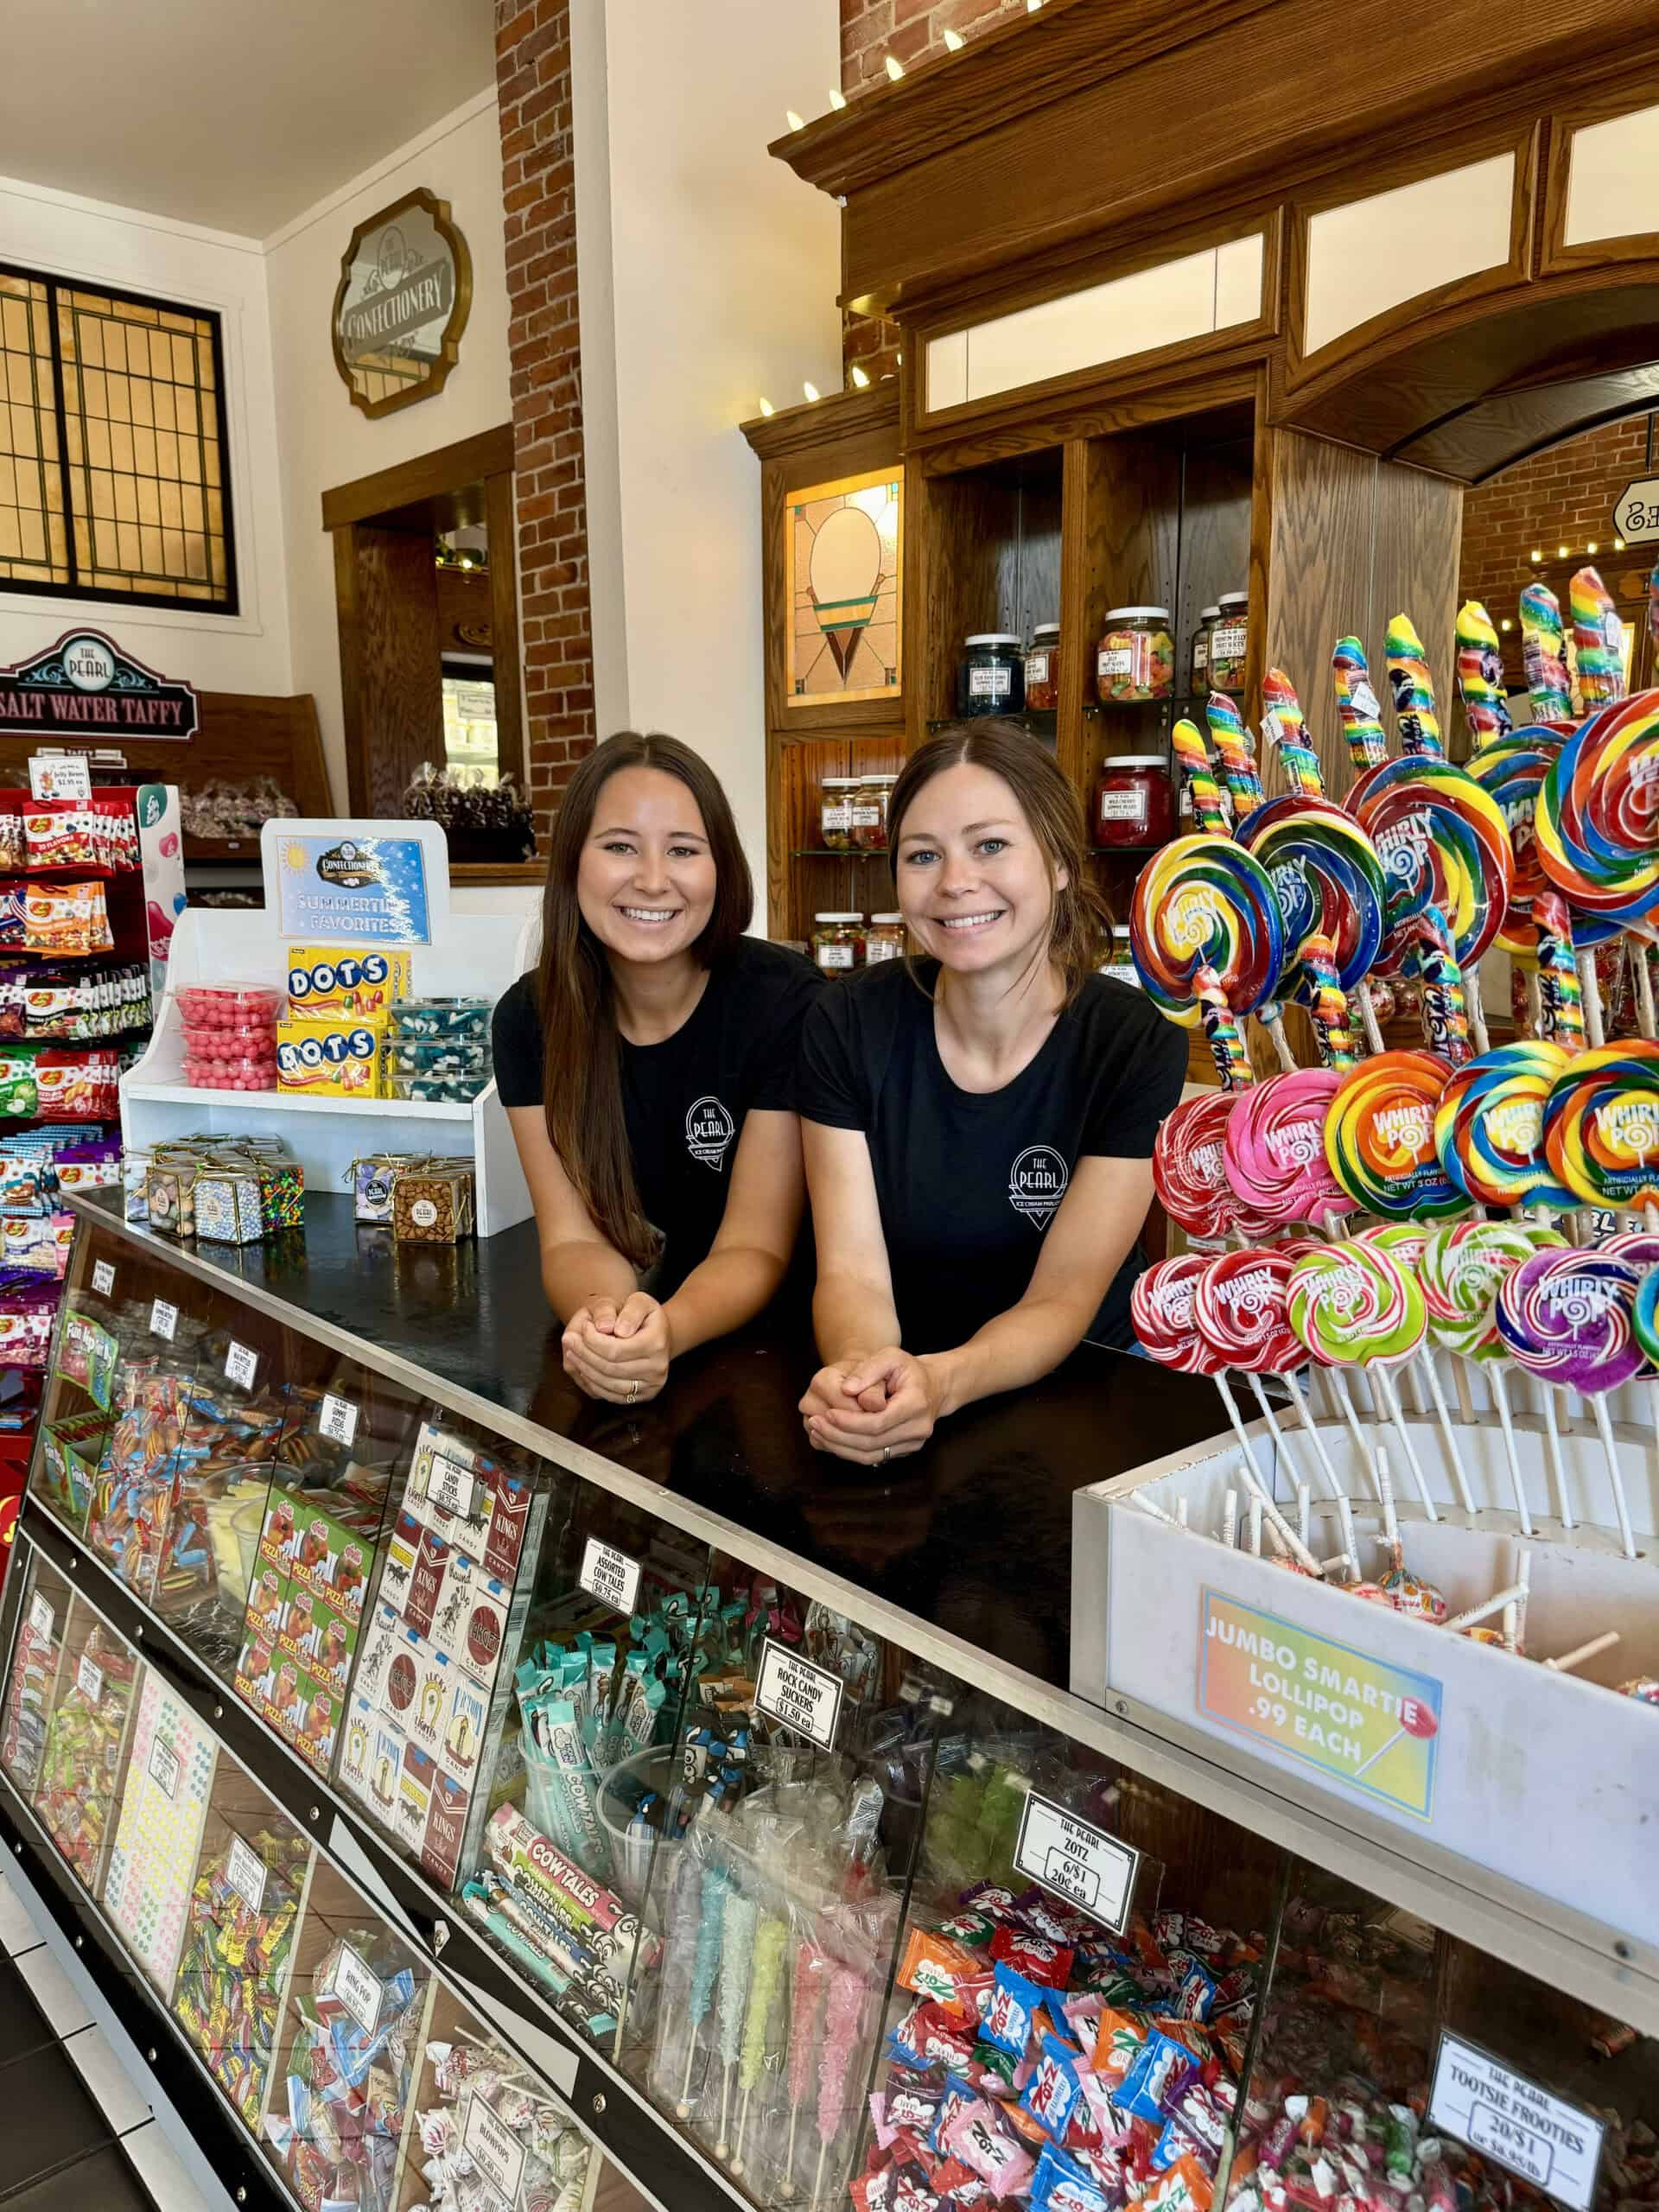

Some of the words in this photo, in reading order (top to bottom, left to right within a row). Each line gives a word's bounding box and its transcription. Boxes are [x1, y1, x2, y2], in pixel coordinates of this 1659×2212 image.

[347, 262, 443, 342] CONFECTIONERY
[79, 648, 95, 658] THE
[68, 659, 111, 678] PEARL
[0, 692, 45, 719] SALT
[48, 694, 118, 724] WATER
[121, 696, 183, 726] TAFFY
[289, 957, 382, 995] DOTS
[277, 1032, 372, 1069] DOTS
[702, 1108, 716, 1119] THE
[694, 1121, 727, 1138] PEARL
[1033, 1158, 1047, 1169] THE
[1020, 1171, 1059, 1189] PEARL
[1383, 1181, 1402, 1192] NET
[1402, 1179, 1415, 1190] WT
[1425, 1177, 1439, 1187] OZ
[1602, 1186, 1618, 1196] NET
[1213, 1266, 1273, 1305] WHIRLY
[1302, 1262, 1365, 1294] WHIRLY
[1539, 1276, 1621, 1300] WHIRLY
[495, 1513, 518, 1540] KINGS
[262, 1540, 278, 1558] PIZZA
[458, 1533, 478, 1550] CANDY
[293, 1561, 311, 1580] PIZZA
[448, 1561, 472, 1585] Round
[487, 1556, 510, 1573] CANDY
[597, 1555, 626, 1580] ASSORTED
[416, 1567, 437, 1593] KINGS
[594, 1566, 607, 1582] COW
[607, 1574, 625, 1592] TALES
[594, 1582, 611, 1599] $0.75
[325, 1587, 344, 1606] PIZZA
[248, 1609, 264, 1628] PIZZA
[279, 1633, 297, 1652] PIZZA
[435, 1631, 455, 1649] CANDY
[311, 1662, 330, 1682] PIZZA
[1205, 1616, 1296, 1671] JUMBO
[1302, 1656, 1418, 1726] SMARTIE
[235, 1674, 252, 1694] PIZZA
[777, 1668, 798, 1689] ROCK
[798, 1680, 823, 1703] CANDY
[1249, 1662, 1365, 1730] LOLLIPOP
[781, 1685, 815, 1713] SUCKERS
[264, 1702, 283, 1723] PIZZA
[779, 1700, 801, 1722] $1.50
[801, 1716, 811, 1729] ea
[1249, 1696, 1287, 1727] .99
[1294, 1714, 1362, 1763] EACH
[296, 1733, 315, 1756] PIZZA
[445, 1757, 468, 1778] CANDY
[433, 1811, 457, 1843] KINGS
[1059, 1817, 1074, 1834] THE
[1075, 1827, 1101, 1851] PEARL
[1064, 1836, 1090, 1863] ZOTZ
[426, 1854, 448, 1874] CANDY
[1062, 1859, 1087, 1883] 6/$1
[560, 1866, 600, 1908] TALES
[1050, 1868, 1073, 1890] 20¢
[1073, 1885, 1087, 1901] ea
[346, 1969, 359, 1992] RING
[359, 1985, 372, 2005] POP
[1030, 2059, 1061, 2118] ZOTZ
[1488, 2066, 1510, 2089] THE
[1512, 2080, 1550, 2113] PEARL
[1450, 2063, 1511, 2113] TOOTSIE
[1511, 2100, 1585, 2155] FROOTIES
[479, 2121, 511, 2164] BLOWPOPS
[971, 2119, 1009, 2165] ZOTZ
